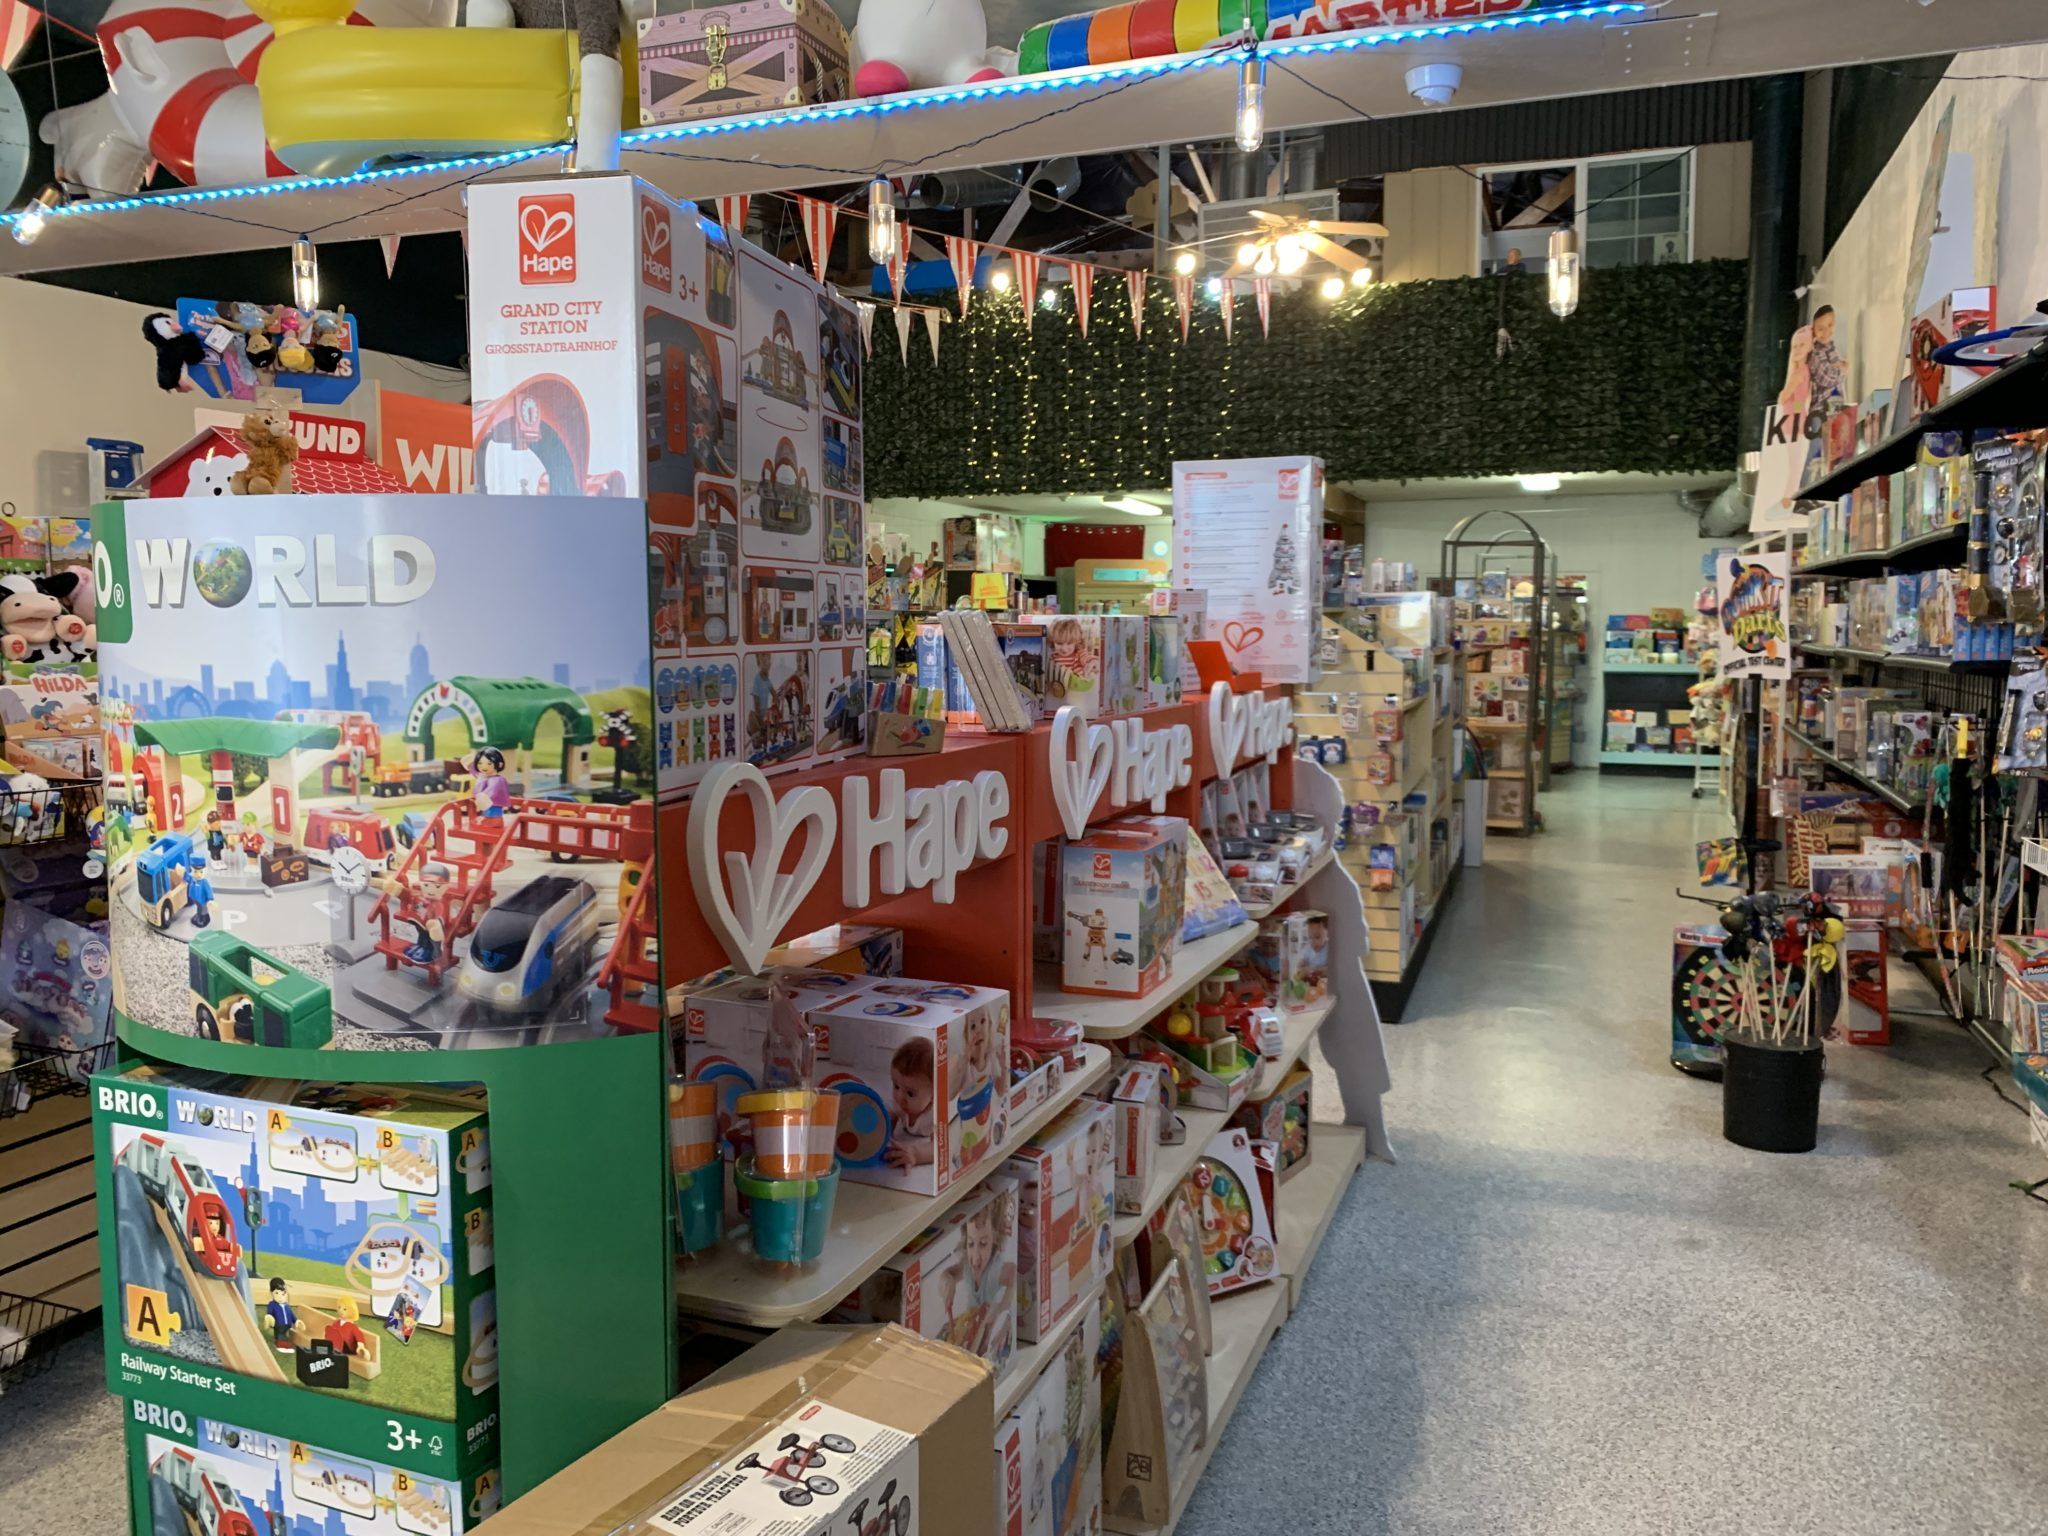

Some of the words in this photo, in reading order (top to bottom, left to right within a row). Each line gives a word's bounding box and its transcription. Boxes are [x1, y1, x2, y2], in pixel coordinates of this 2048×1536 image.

[523, 254, 574, 276] Hape
[643, 253, 672, 282] Hape
[678, 274, 699, 302] 3+
[500, 302, 560, 319] GRAND
[564, 300, 603, 316] CITY
[520, 319, 588, 336] STATION
[484, 339, 619, 355] GROSSSTADTBAHNHOF
[289, 420, 361, 455] UND
[135, 534, 436, 609] WORLD
[1748, 656, 1762, 666] TEST
[1243, 690, 1294, 765] Hape
[1111, 717, 1193, 813] Hape
[842, 768, 1010, 905] Hape
[176, 1099, 258, 1134] WORLD
[271, 1112, 283, 1130] A
[383, 1130, 393, 1148] B
[466, 1133, 476, 1150] A
[471, 1212, 480, 1230] B
[136, 1295, 162, 1337] A
[121, 1352, 168, 1381] Railway
[169, 1366, 213, 1390] Starter
[214, 1377, 237, 1395] Set
[121, 1371, 143, 1385] 33773
[204, 1419, 281, 1461] WORLD
[386, 1419, 423, 1451] 3+
[292, 1444, 304, 1461] A
[398, 1474, 409, 1492] B
[660, 1505, 685, 1522] RIDE
[688, 1474, 728, 1501] TRACTOR
[672, 1501, 713, 1528] PORTEUR
[705, 1473, 749, 1503] TRACTEUR
